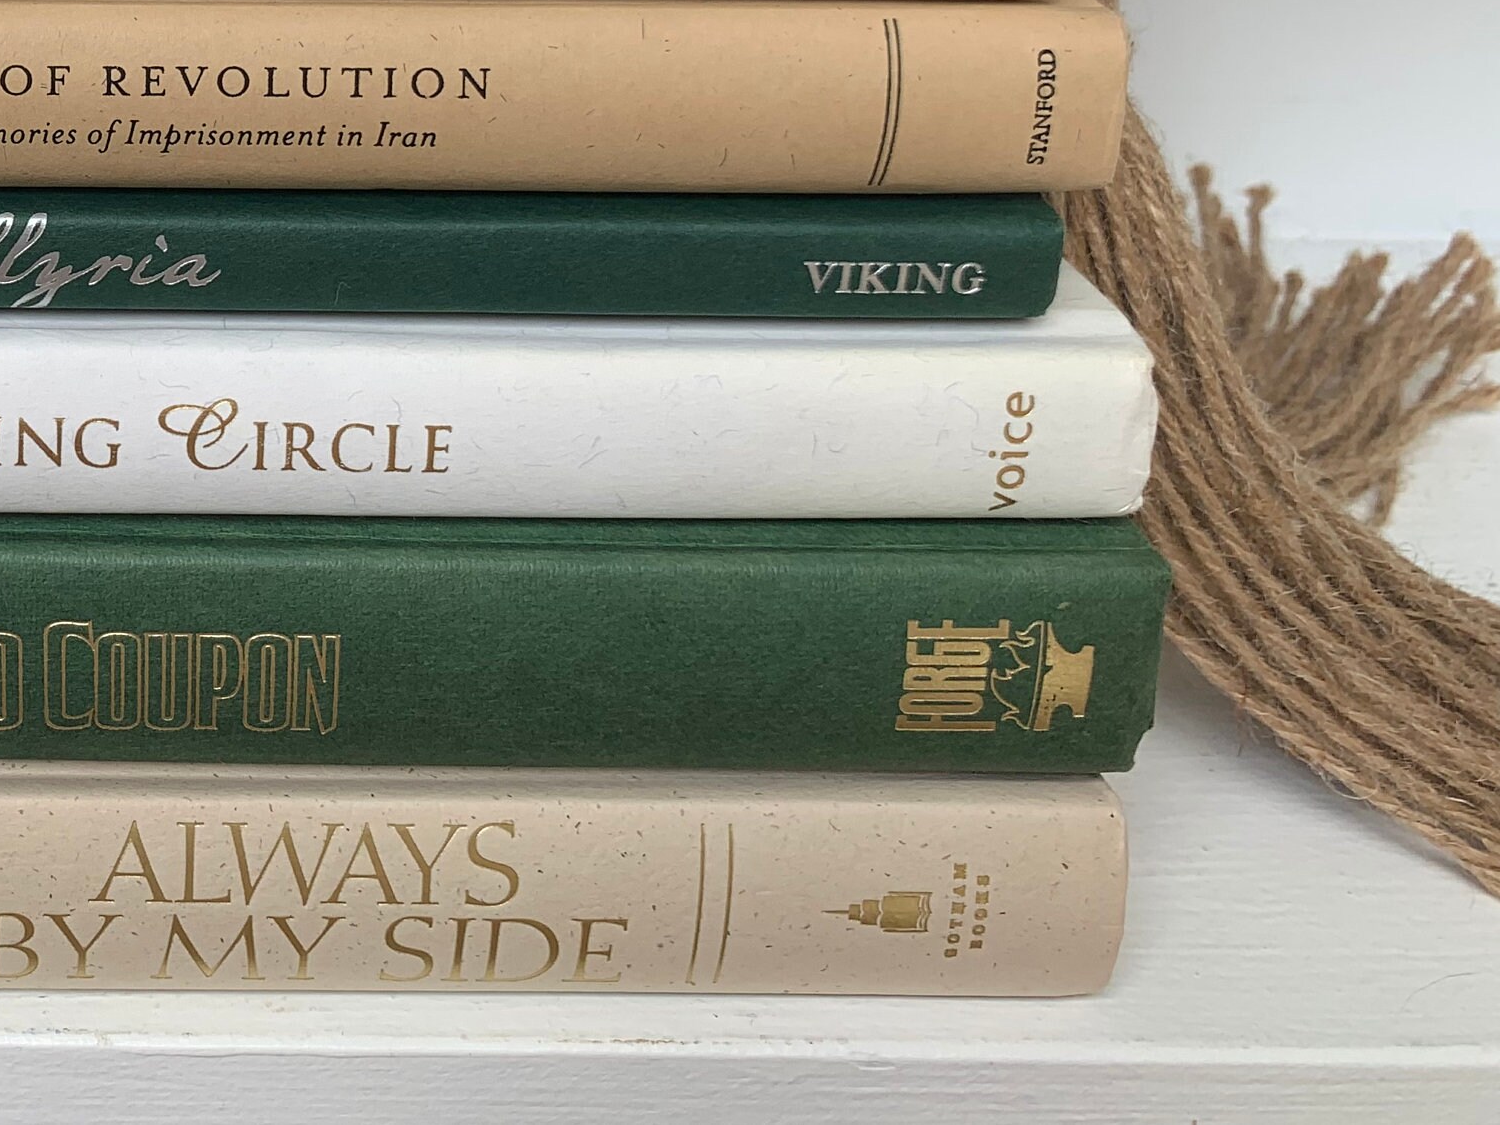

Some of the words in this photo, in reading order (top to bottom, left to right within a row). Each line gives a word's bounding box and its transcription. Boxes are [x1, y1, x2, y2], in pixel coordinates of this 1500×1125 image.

[0, 64, 72, 97] OF
[102, 64, 494, 100] REVOLUTION
[1026, 48, 1057, 166] STANFORD
[86, 118, 118, 154] of
[125, 119, 327, 153] Imprisonment
[336, 121, 364, 148] in
[373, 121, 438, 149] Iran
[804, 260, 988, 295] VIKING
[157, 397, 454, 474] CIRCLE
[988, 391, 1035, 511] voice
[43, 620, 342, 735] COUPON
[895, 619, 1010, 732] FORGE
[89, 820, 520, 907] ALWAYS
[150, 913, 338, 981] MY
[379, 915, 628, 982] SIDE
